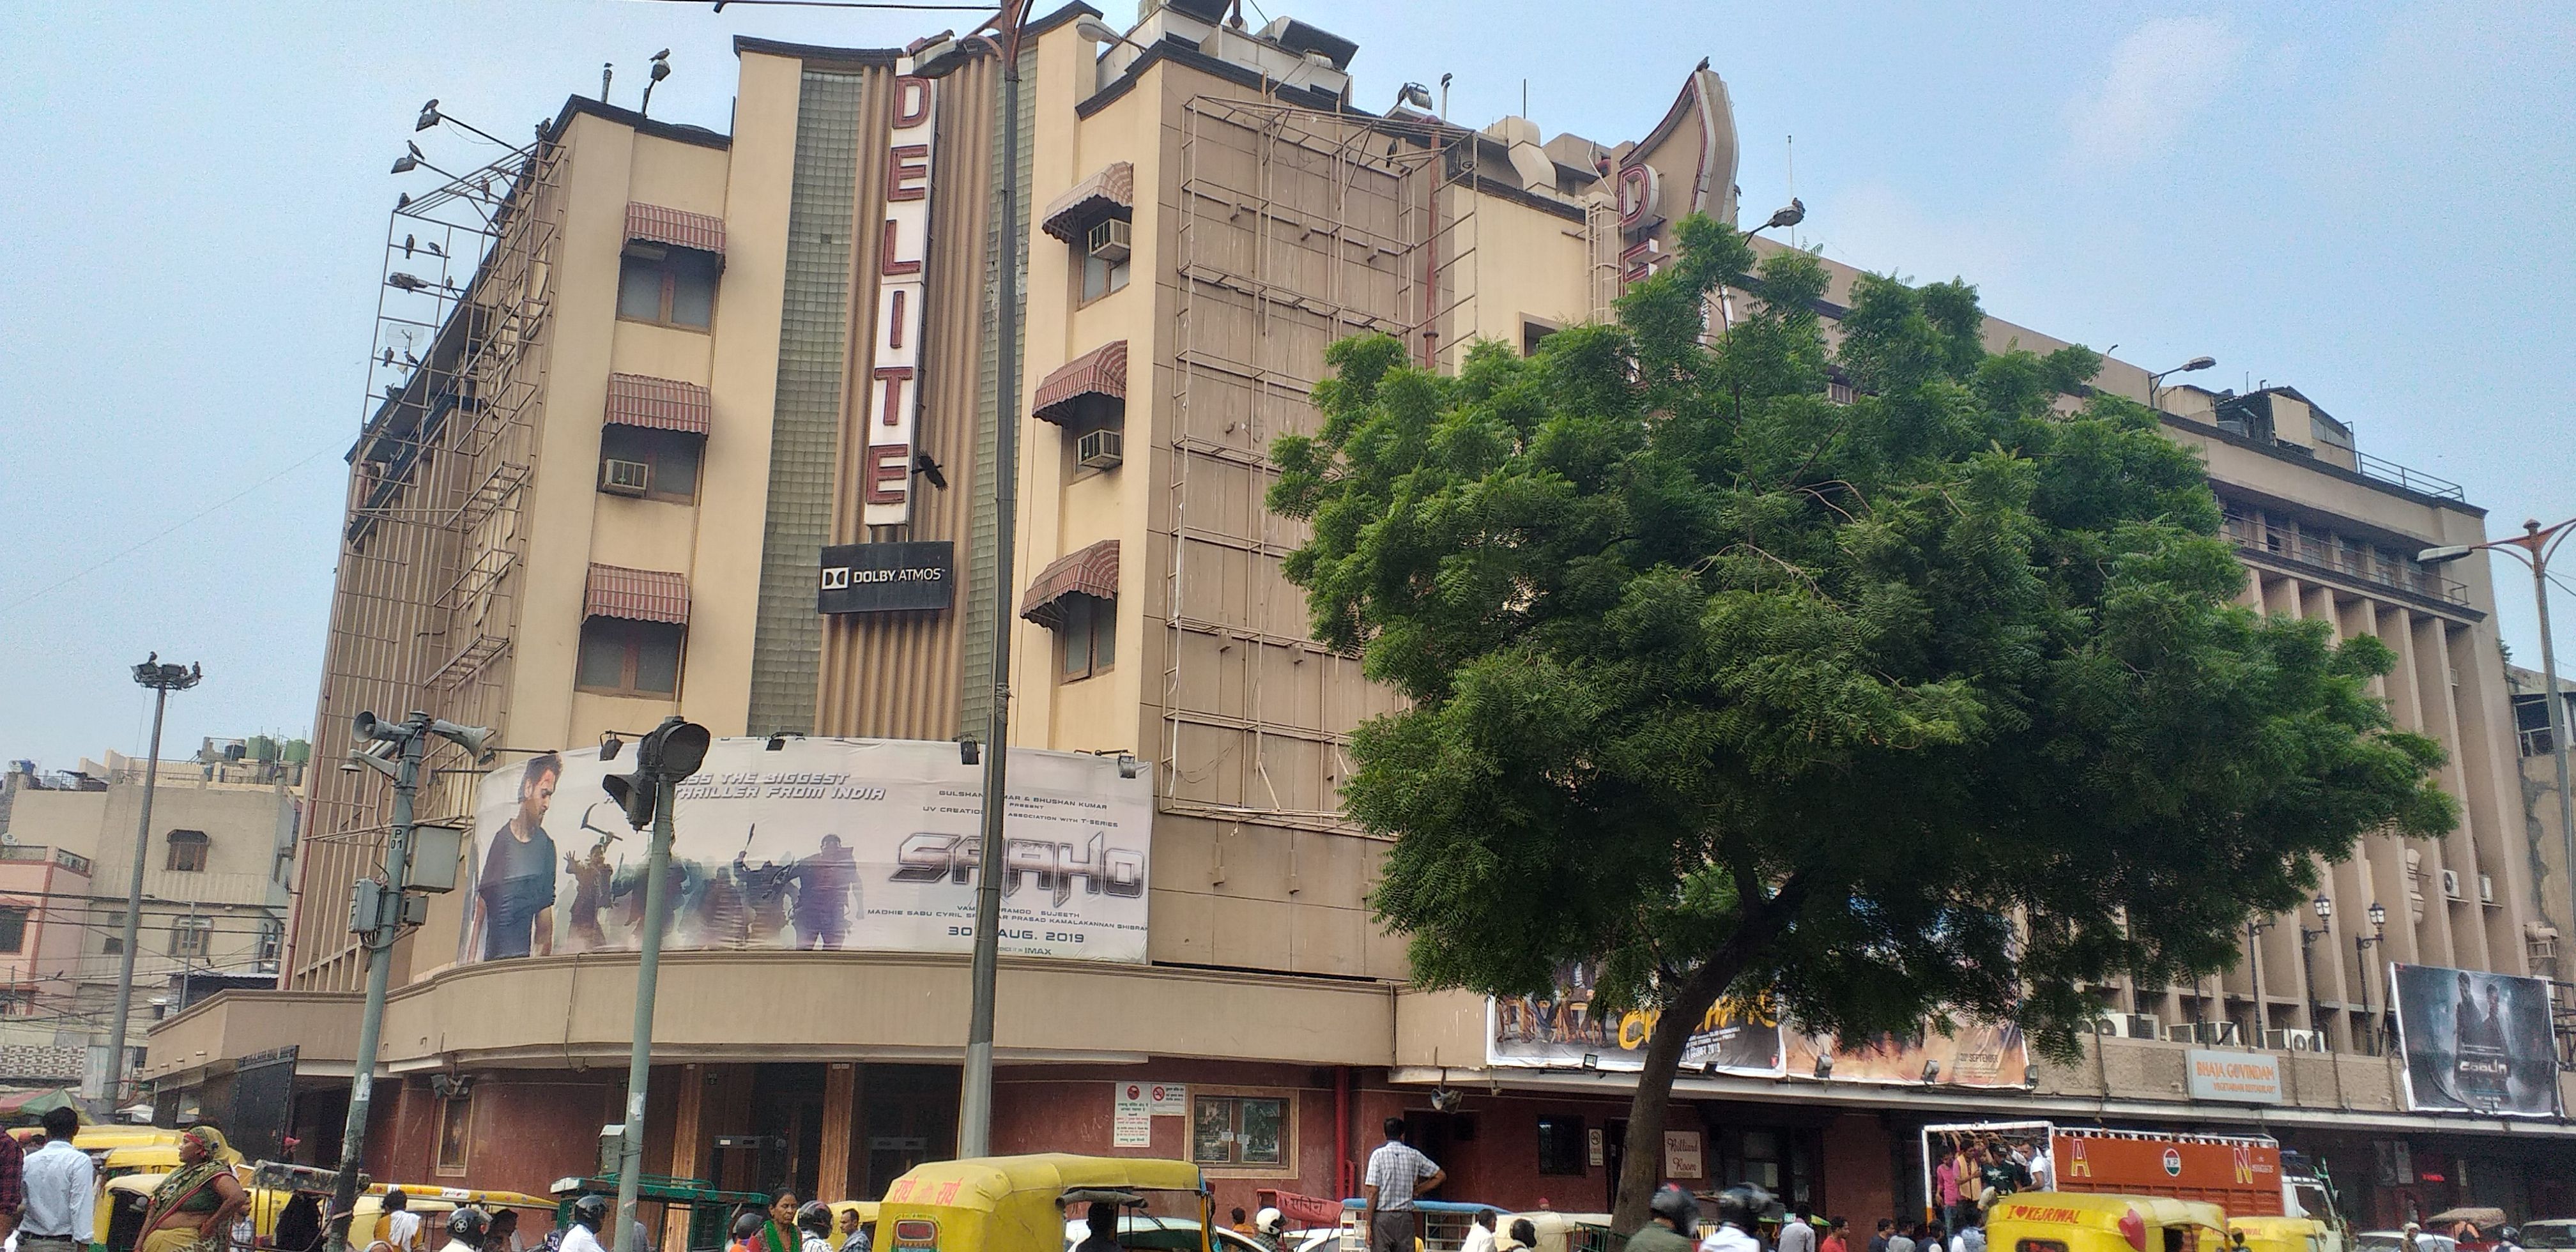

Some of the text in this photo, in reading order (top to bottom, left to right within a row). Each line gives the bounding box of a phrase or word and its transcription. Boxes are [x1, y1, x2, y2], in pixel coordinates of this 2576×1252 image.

[866, 75, 931, 505] DELITE
[853, 567, 942, 583] DOLBY ATMOS
[721, 773, 758, 784] THE
[763, 772, 850, 785] BIGGEST
[675, 786, 886, 800] THRILLER FROM INDIA
[939, 790, 983, 798] GULSHAN
[1033, 797, 1075, 806] BHUSHAN
[1078, 802, 1108, 810] KUMAR
[1008, 813, 1057, 821] ASSOCIATION
[1081, 818, 1118, 828] T-SERIES
[394, 829, 402, 839] P
[390, 839, 402, 849] 01
[1049, 919, 1115, 928] KAMALAKANNAN
[997, 929, 1038, 940] AUG.
[1045, 931, 1085, 943] 2019
[1024, 947, 1052, 956] IMAX
[1968, 1053, 1999, 1063] SEPTEMBER
[2196, 1061, 2274, 1081] BHAJA GOVINDAM
[2071, 1138, 2091, 1178] A
[2234, 1147, 2253, 1184] N
[2007, 1205, 2081, 1225] I KEJRIWAL
